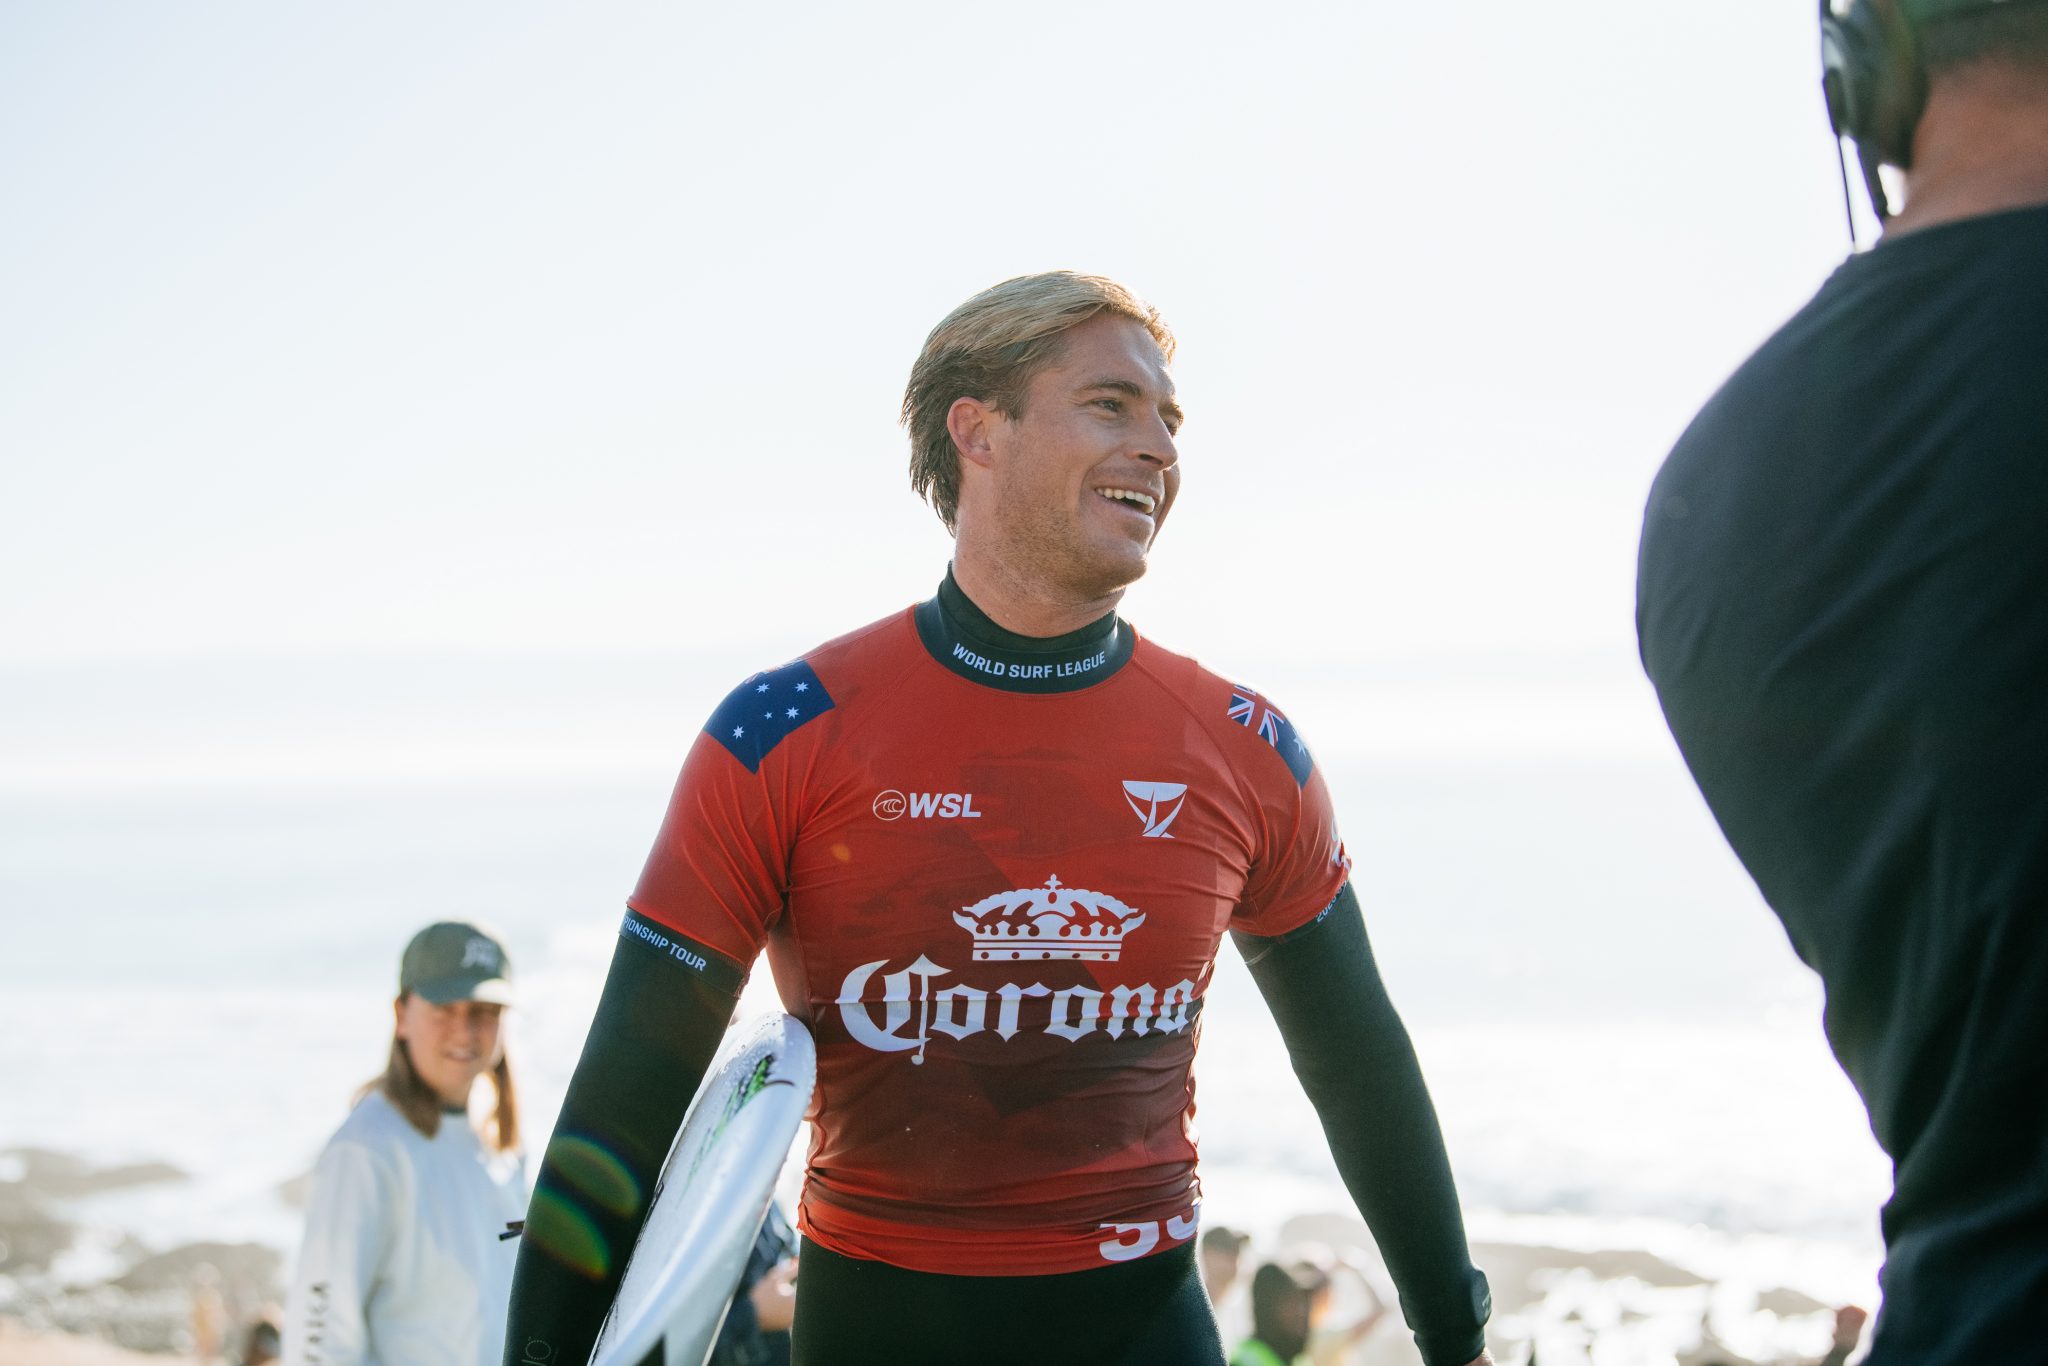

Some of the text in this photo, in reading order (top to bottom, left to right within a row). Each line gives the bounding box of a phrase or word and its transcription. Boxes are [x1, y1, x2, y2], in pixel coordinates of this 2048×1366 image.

[953, 643, 1106, 678] WORLD SURF LEAGUE
[909, 792, 982, 818] WSL
[669, 943, 707, 971] TOUR
[836, 953, 1196, 1065] Corona
